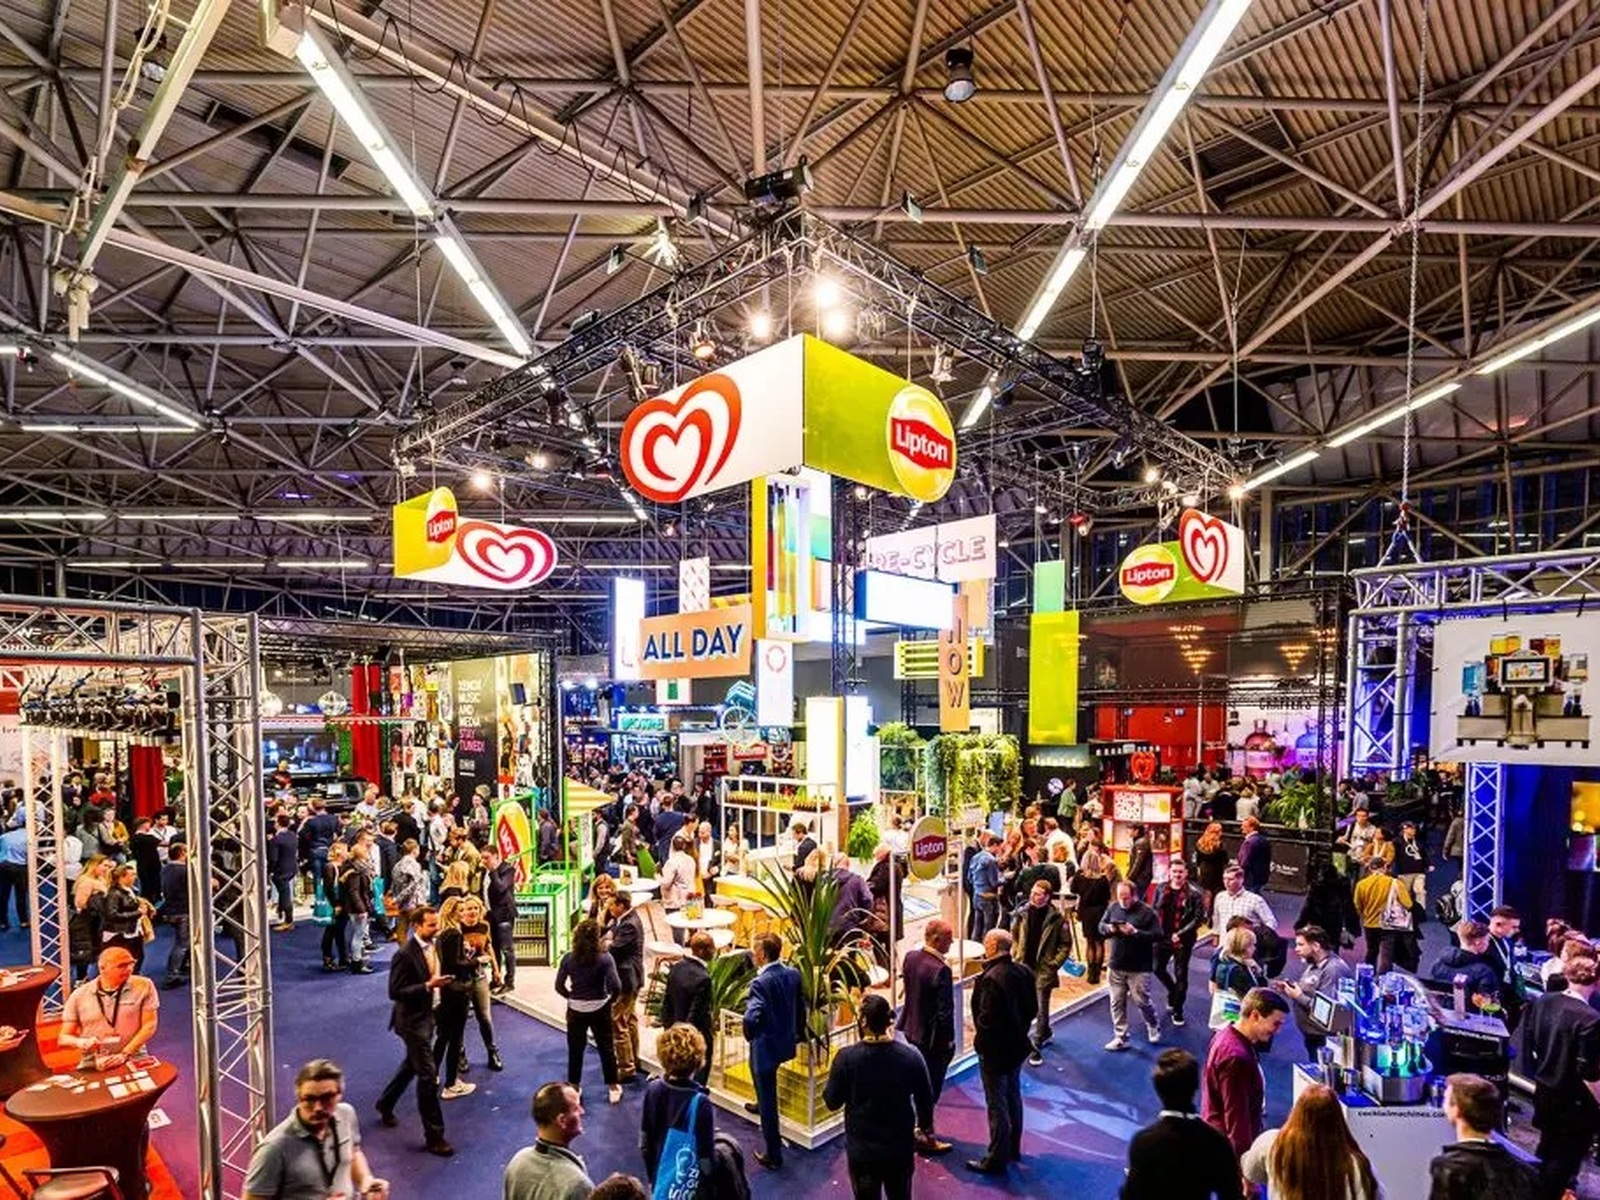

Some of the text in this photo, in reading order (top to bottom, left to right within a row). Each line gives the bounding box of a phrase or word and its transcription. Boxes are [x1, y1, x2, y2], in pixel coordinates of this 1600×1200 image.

[895, 423, 948, 463] Lipton
[429, 517, 454, 539] Lipton
[1126, 566, 1171, 585] Lipton
[644, 623, 744, 662] ALL DAY
[915, 841, 945, 858] Lipton
